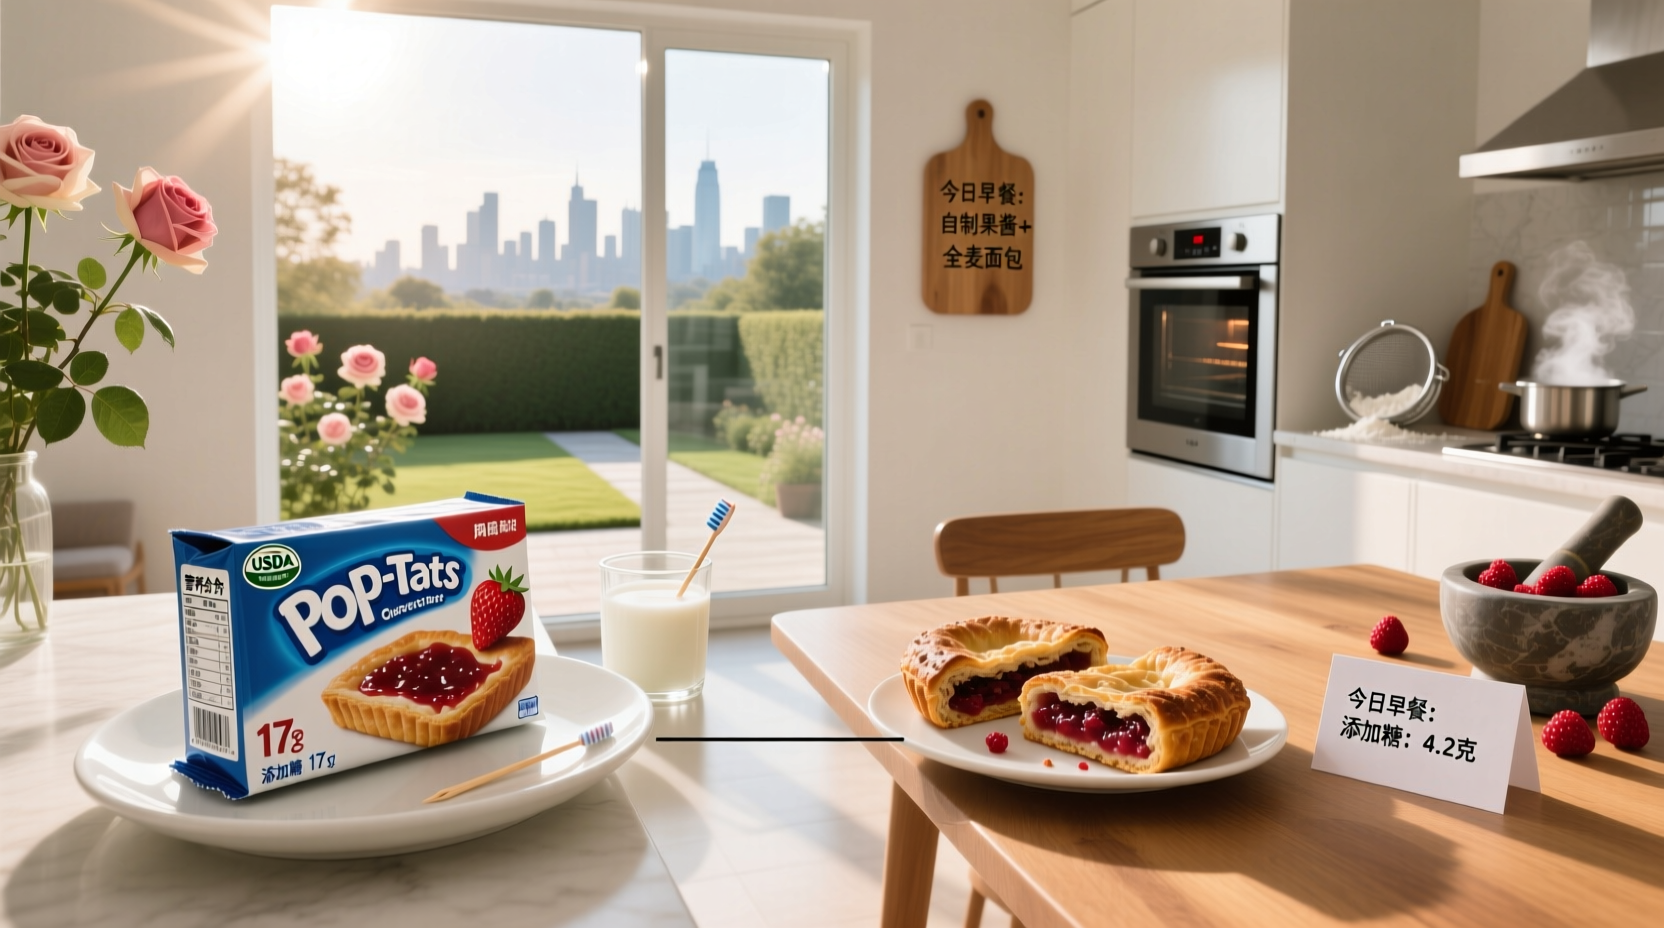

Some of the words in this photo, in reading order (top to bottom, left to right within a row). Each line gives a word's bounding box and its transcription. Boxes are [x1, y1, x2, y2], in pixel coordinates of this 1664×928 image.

[940, 179, 1024, 206] 今日早餐：
[941, 212, 1032, 236] 自制果酱+
[942, 244, 1023, 270] 全麦面包
[252, 554, 295, 571] USDA
[1348, 687, 1436, 722] 今日早餐：
